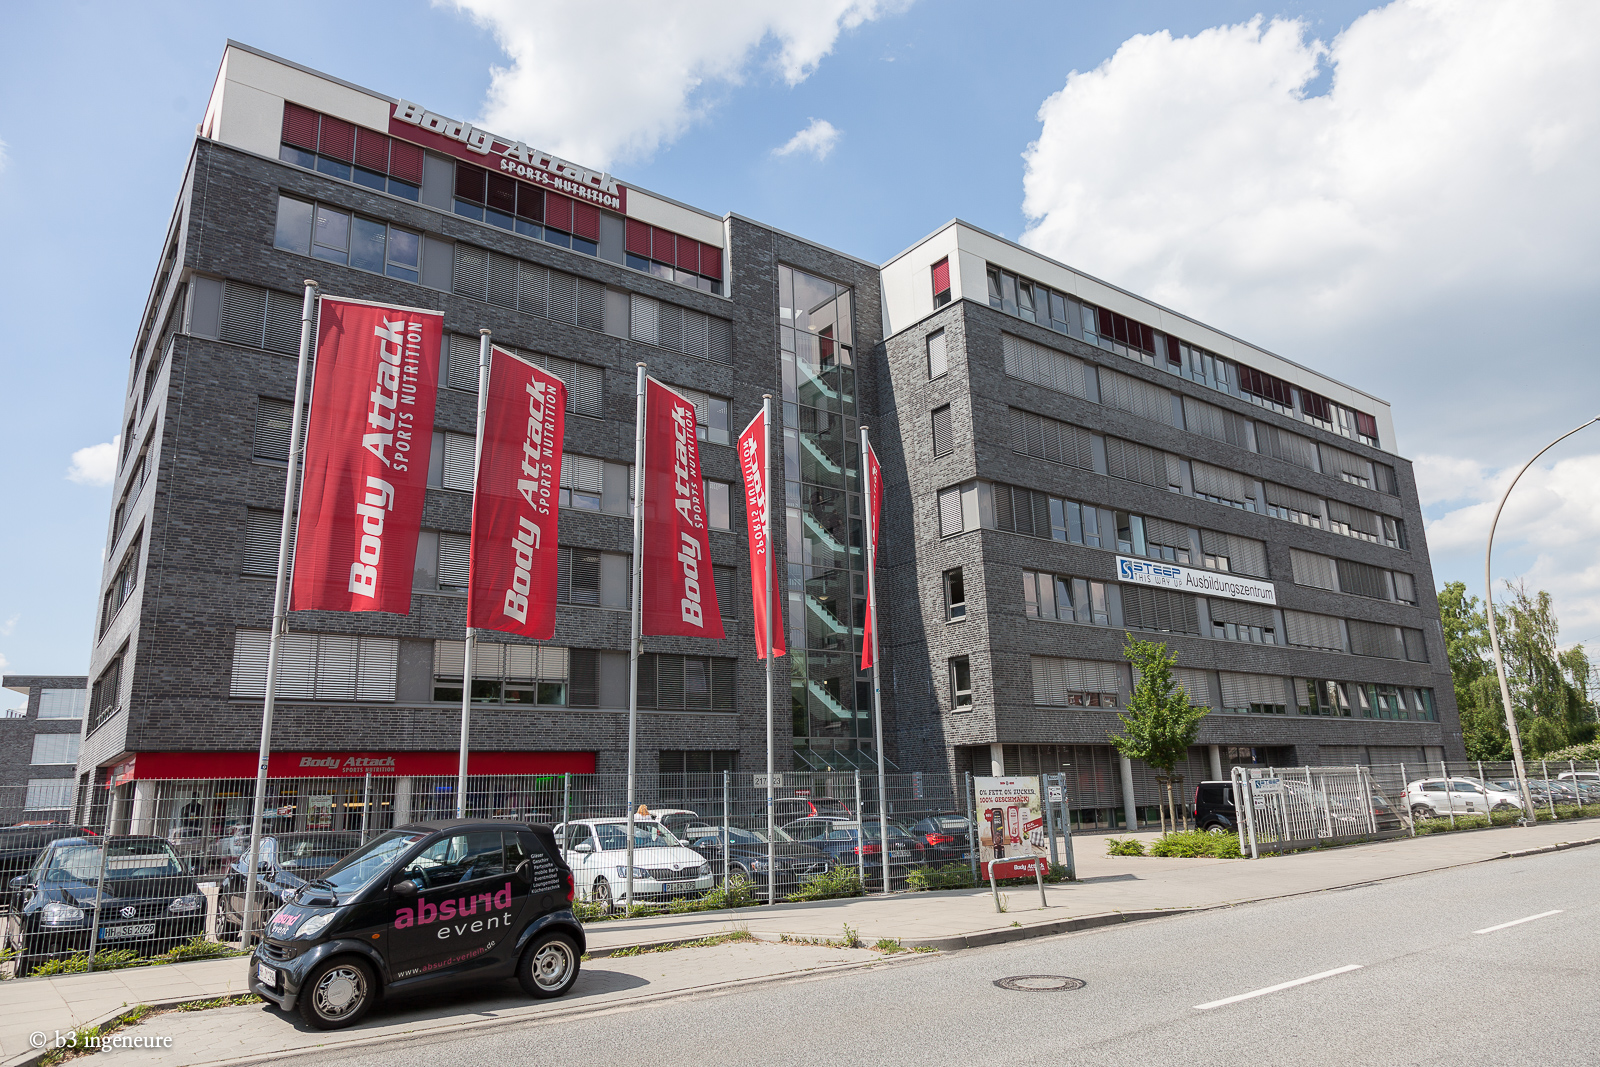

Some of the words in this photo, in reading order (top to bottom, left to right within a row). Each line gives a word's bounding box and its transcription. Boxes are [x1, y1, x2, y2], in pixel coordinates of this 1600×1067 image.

[392, 98, 495, 155] Body
[500, 141, 621, 197] Attack
[500, 159, 549, 185] SPORTS
[554, 177, 620, 210] NUTRITION
[362, 315, 405, 468] Attack
[401, 322, 423, 405] NUTRITION
[393, 412, 414, 472] SPORTS
[517, 375, 546, 511] Attack
[543, 385, 557, 458] NUTRITION
[685, 409, 698, 478] NUTRITION
[538, 464, 552, 516] SPORTS
[671, 401, 694, 527] Attack
[694, 484, 704, 529] SPORTS
[348, 476, 395, 599] Body
[503, 516, 541, 625] Body
[680, 531, 704, 629] Body
[1133, 561, 1180, 578] STEEP
[1134, 573, 1151, 583] THIS
[1155, 577, 1170, 586] WAY
[1186, 572, 1274, 600] Ausbildungszentrum
[299, 757, 341, 769] Body
[343, 757, 396, 767] Attack
[105, 928, 117, 937] HH
[122, 926, 133, 936] SG
[134, 924, 155, 935] 2629
[394, 881, 512, 930] absurd
[437, 911, 512, 940] event
[397, 940, 496, 978] www.absurd-verleih.de
